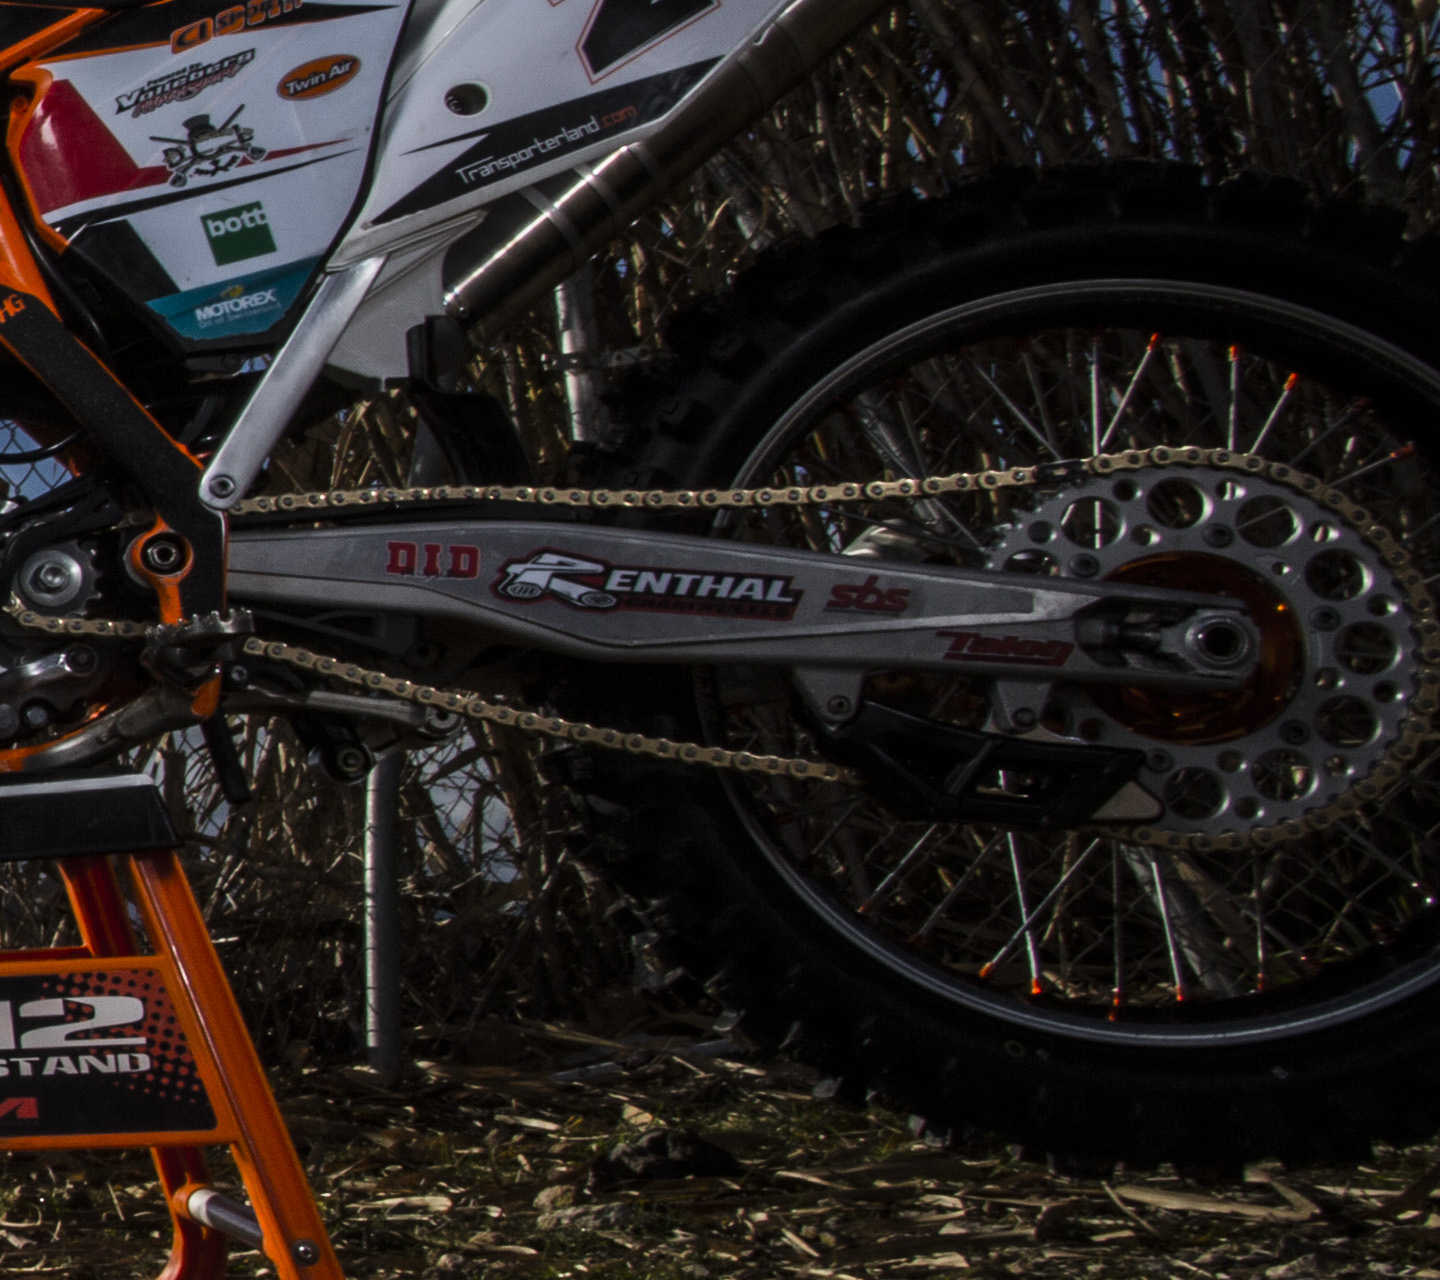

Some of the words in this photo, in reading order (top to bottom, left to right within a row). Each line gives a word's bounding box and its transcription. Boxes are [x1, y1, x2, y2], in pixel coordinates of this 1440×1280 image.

[285, 72, 326, 95] Twin
[328, 60, 355, 78] Air
[206, 207, 267, 238] bott
[194, 288, 278, 322] MOTOREX
[826, 575, 912, 612] sbs
